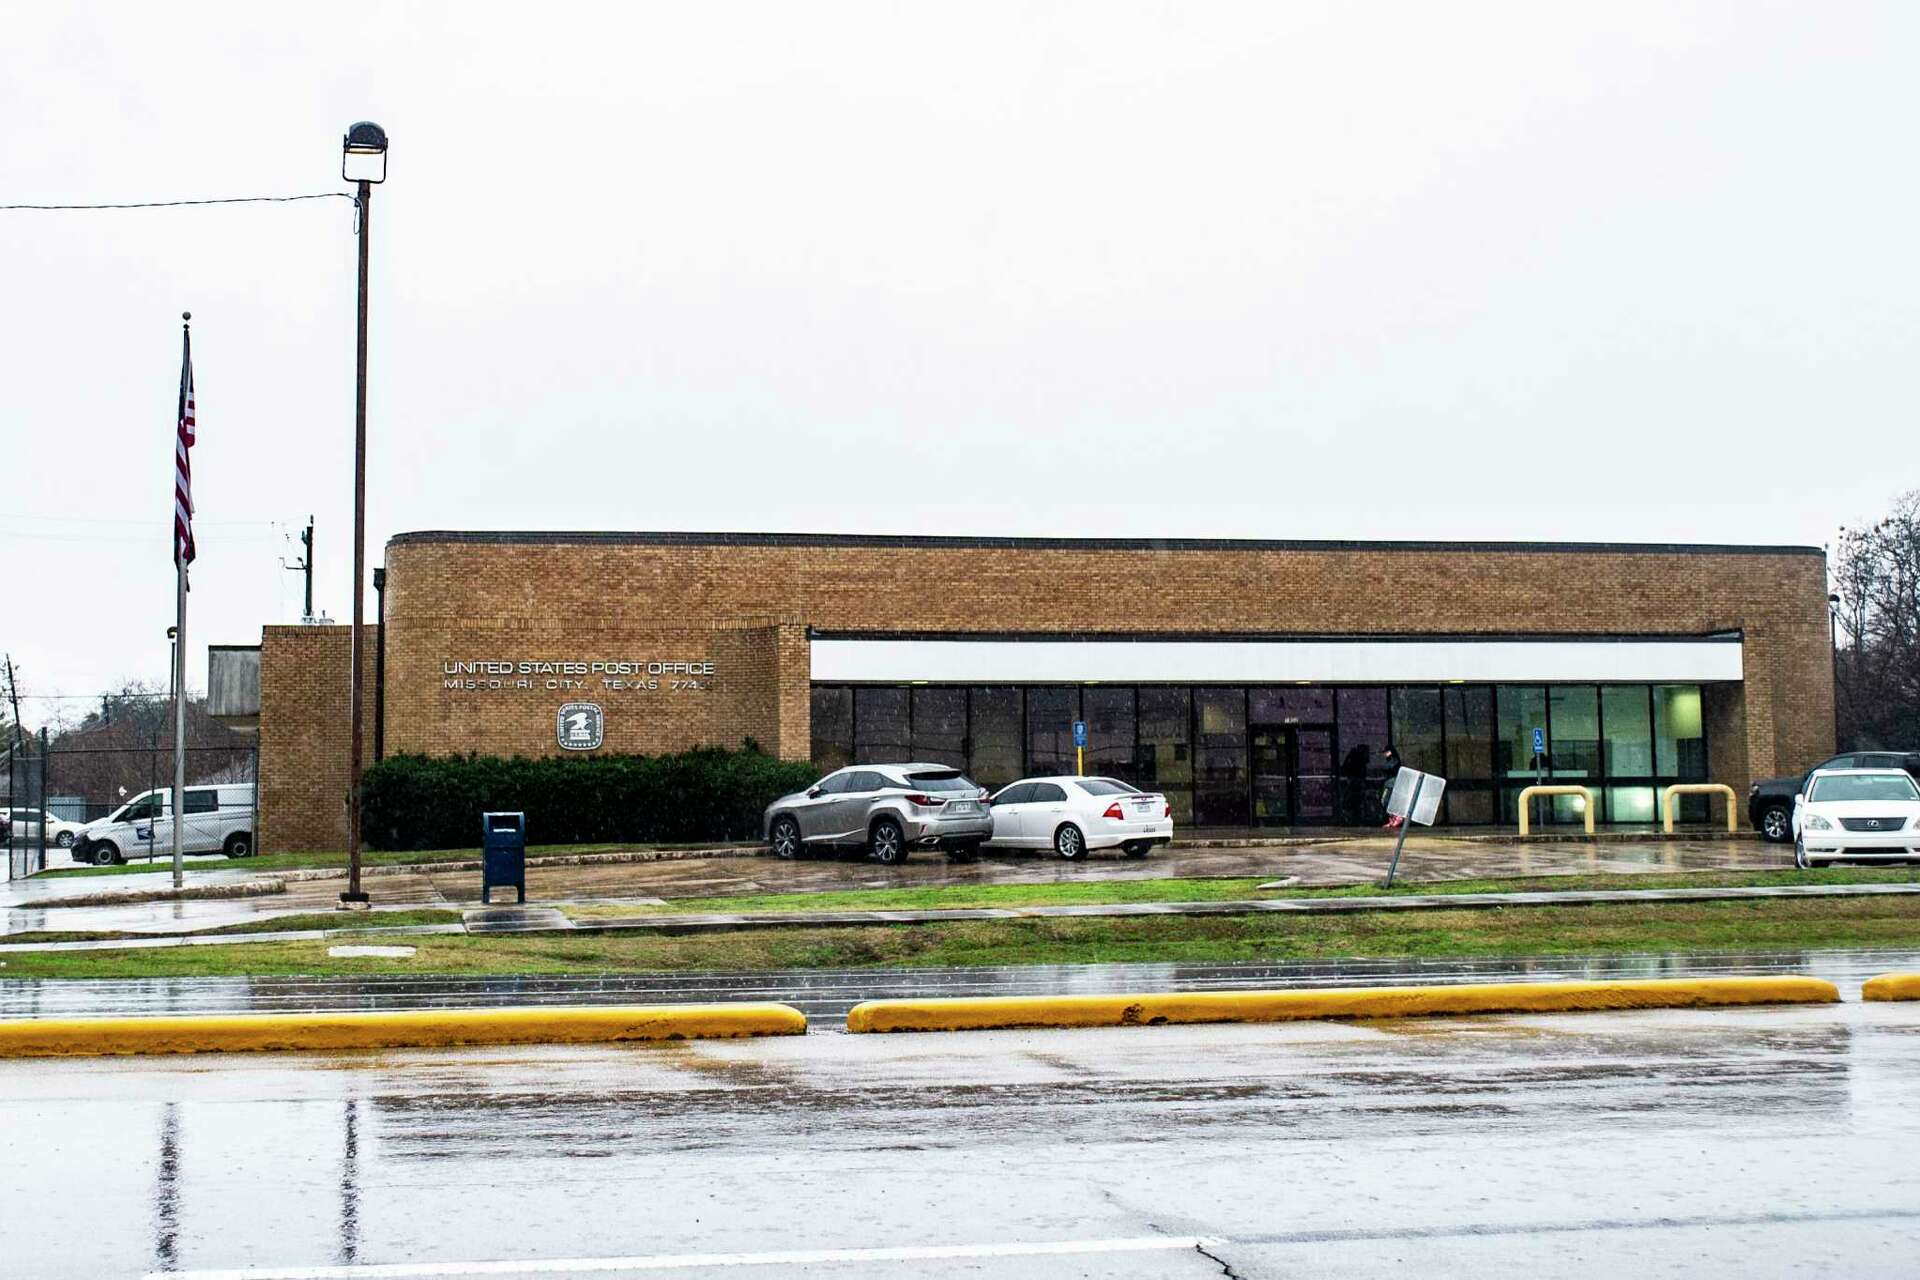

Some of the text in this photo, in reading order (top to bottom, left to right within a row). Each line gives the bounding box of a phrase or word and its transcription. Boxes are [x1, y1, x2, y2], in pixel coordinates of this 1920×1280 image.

[444, 661, 715, 675] UNITED STATES POST OFFICE
[444, 679, 533, 689] MISSOURI
[602, 680, 658, 690] TEXAS
